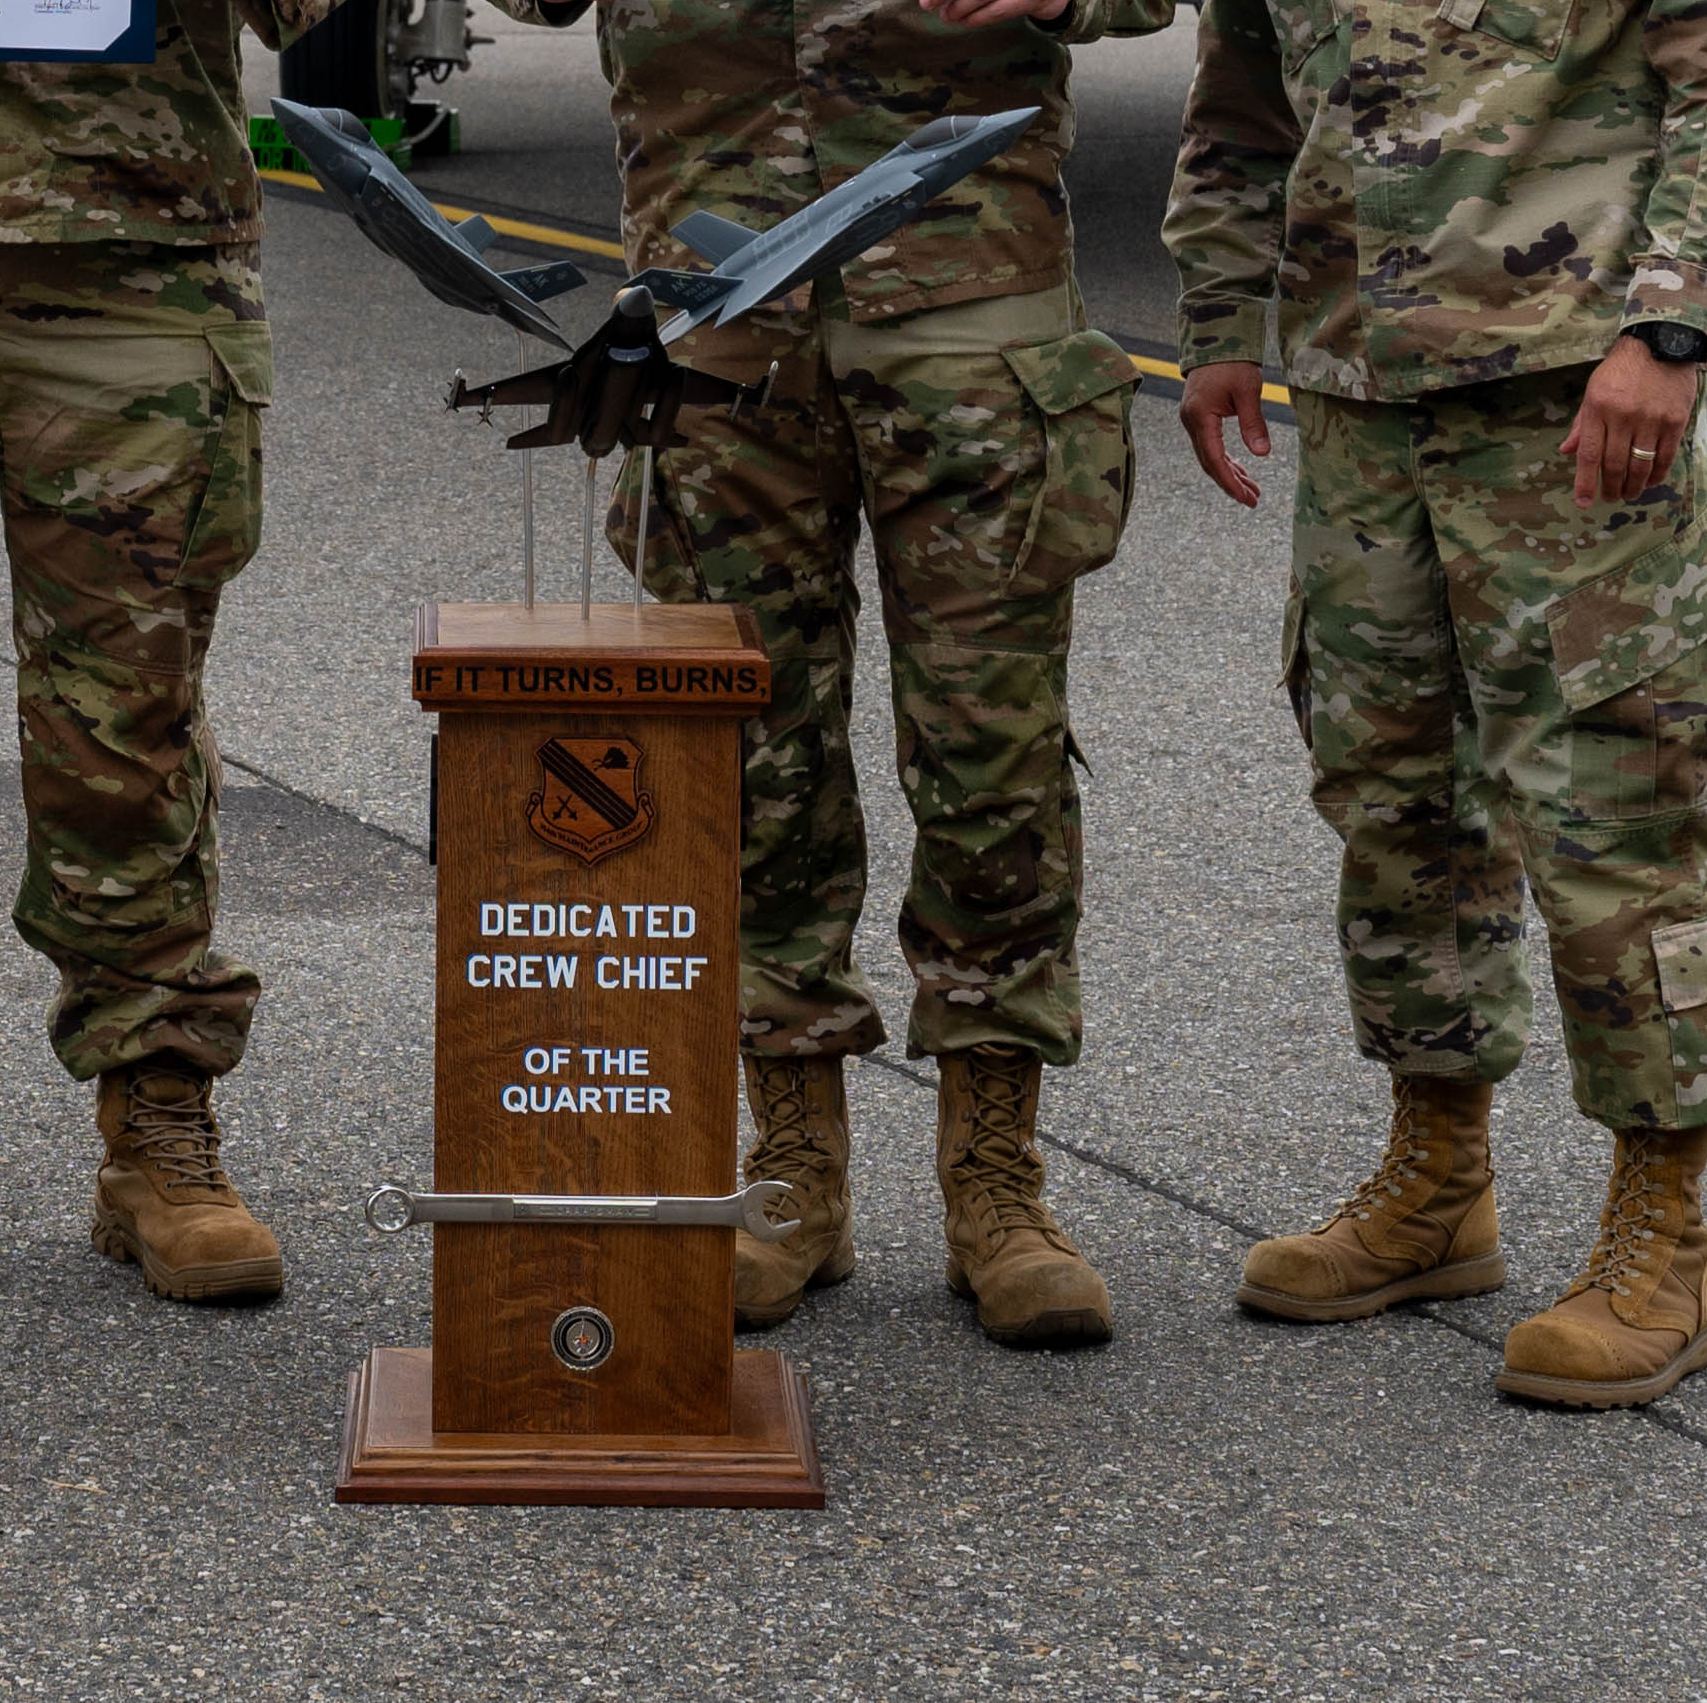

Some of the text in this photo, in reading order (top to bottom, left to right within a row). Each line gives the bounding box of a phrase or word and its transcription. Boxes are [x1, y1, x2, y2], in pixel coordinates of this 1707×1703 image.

[414, 665, 768, 698] IF IT TURNS, BURNS,
[480, 902, 697, 939] DEDICATED
[466, 953, 709, 991] CREW CHIEF
[523, 1047, 650, 1076] OF THE
[500, 1084, 673, 1115] QUARTER
